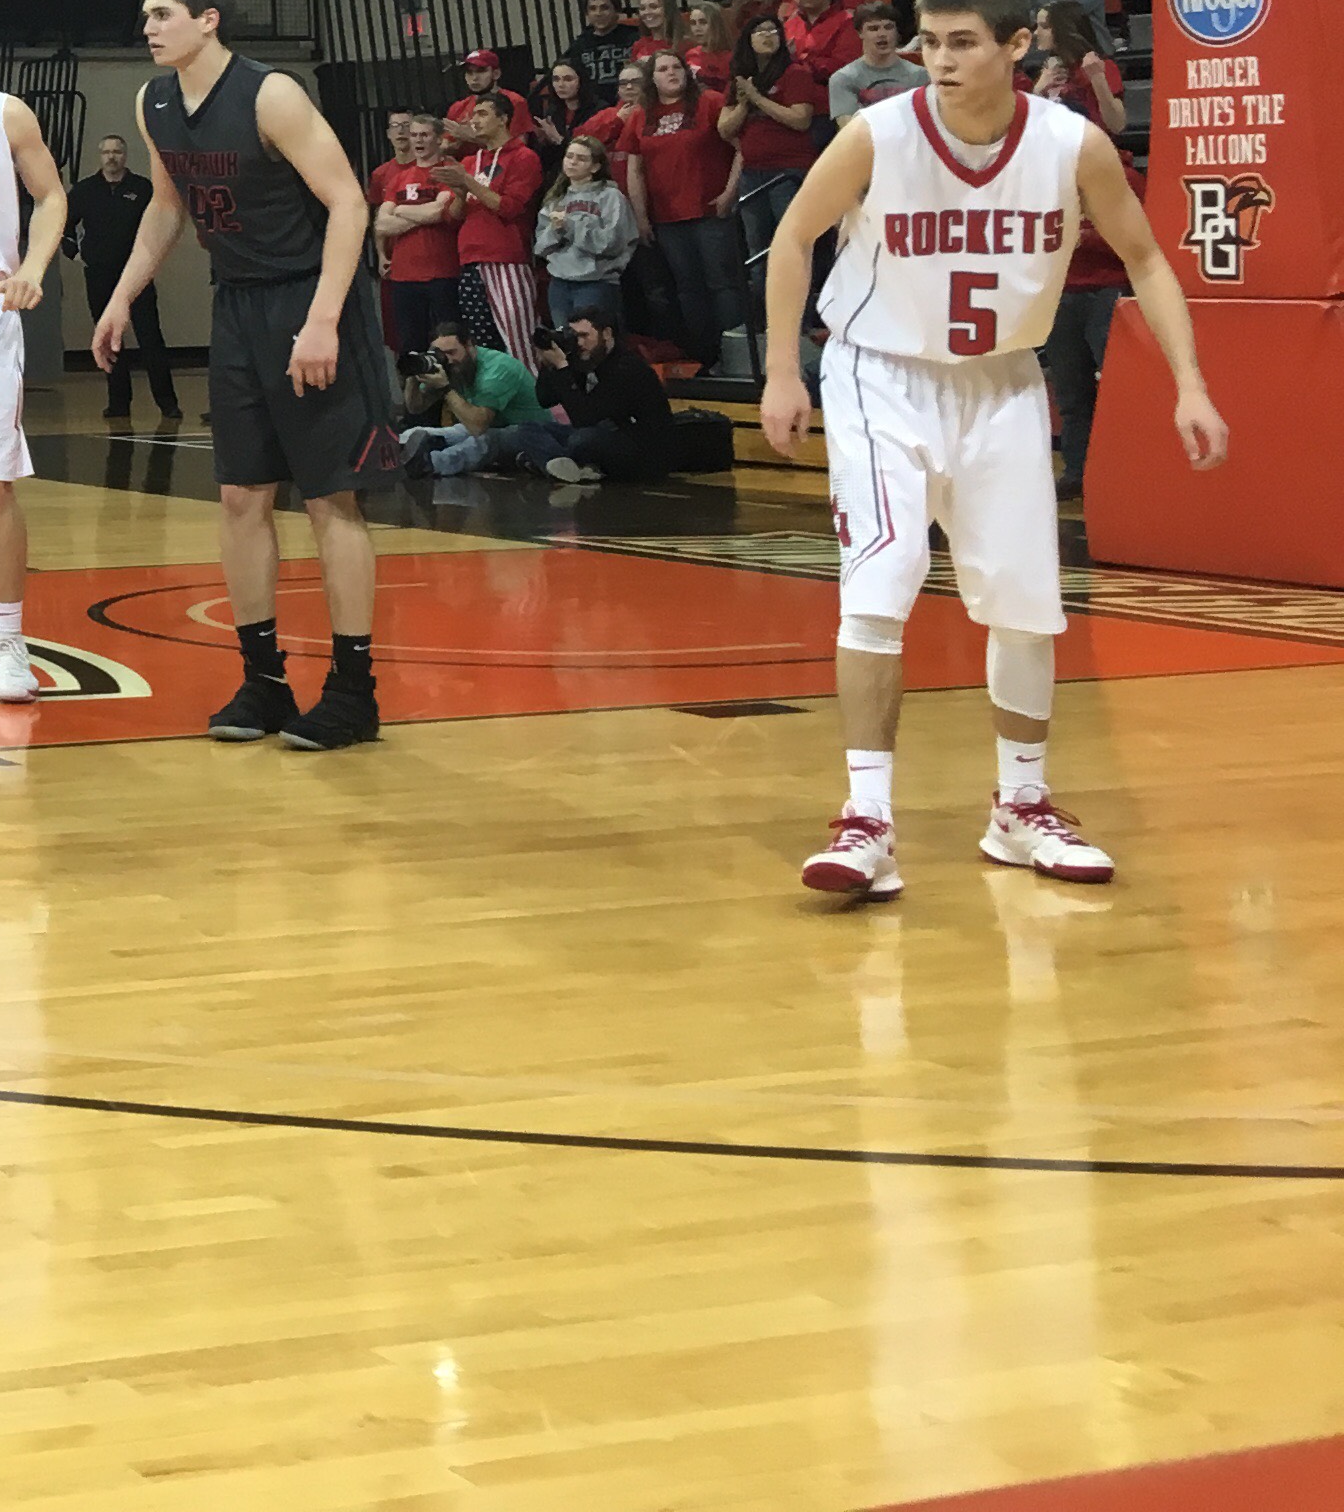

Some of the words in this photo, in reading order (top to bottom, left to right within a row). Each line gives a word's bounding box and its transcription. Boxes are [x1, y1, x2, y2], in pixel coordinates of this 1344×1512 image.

[1168, 97, 1236, 130] DRIVES
[1242, 93, 1286, 127] THE
[884, 208, 1065, 258] ROCKETS
[948, 270, 1000, 357] 5
